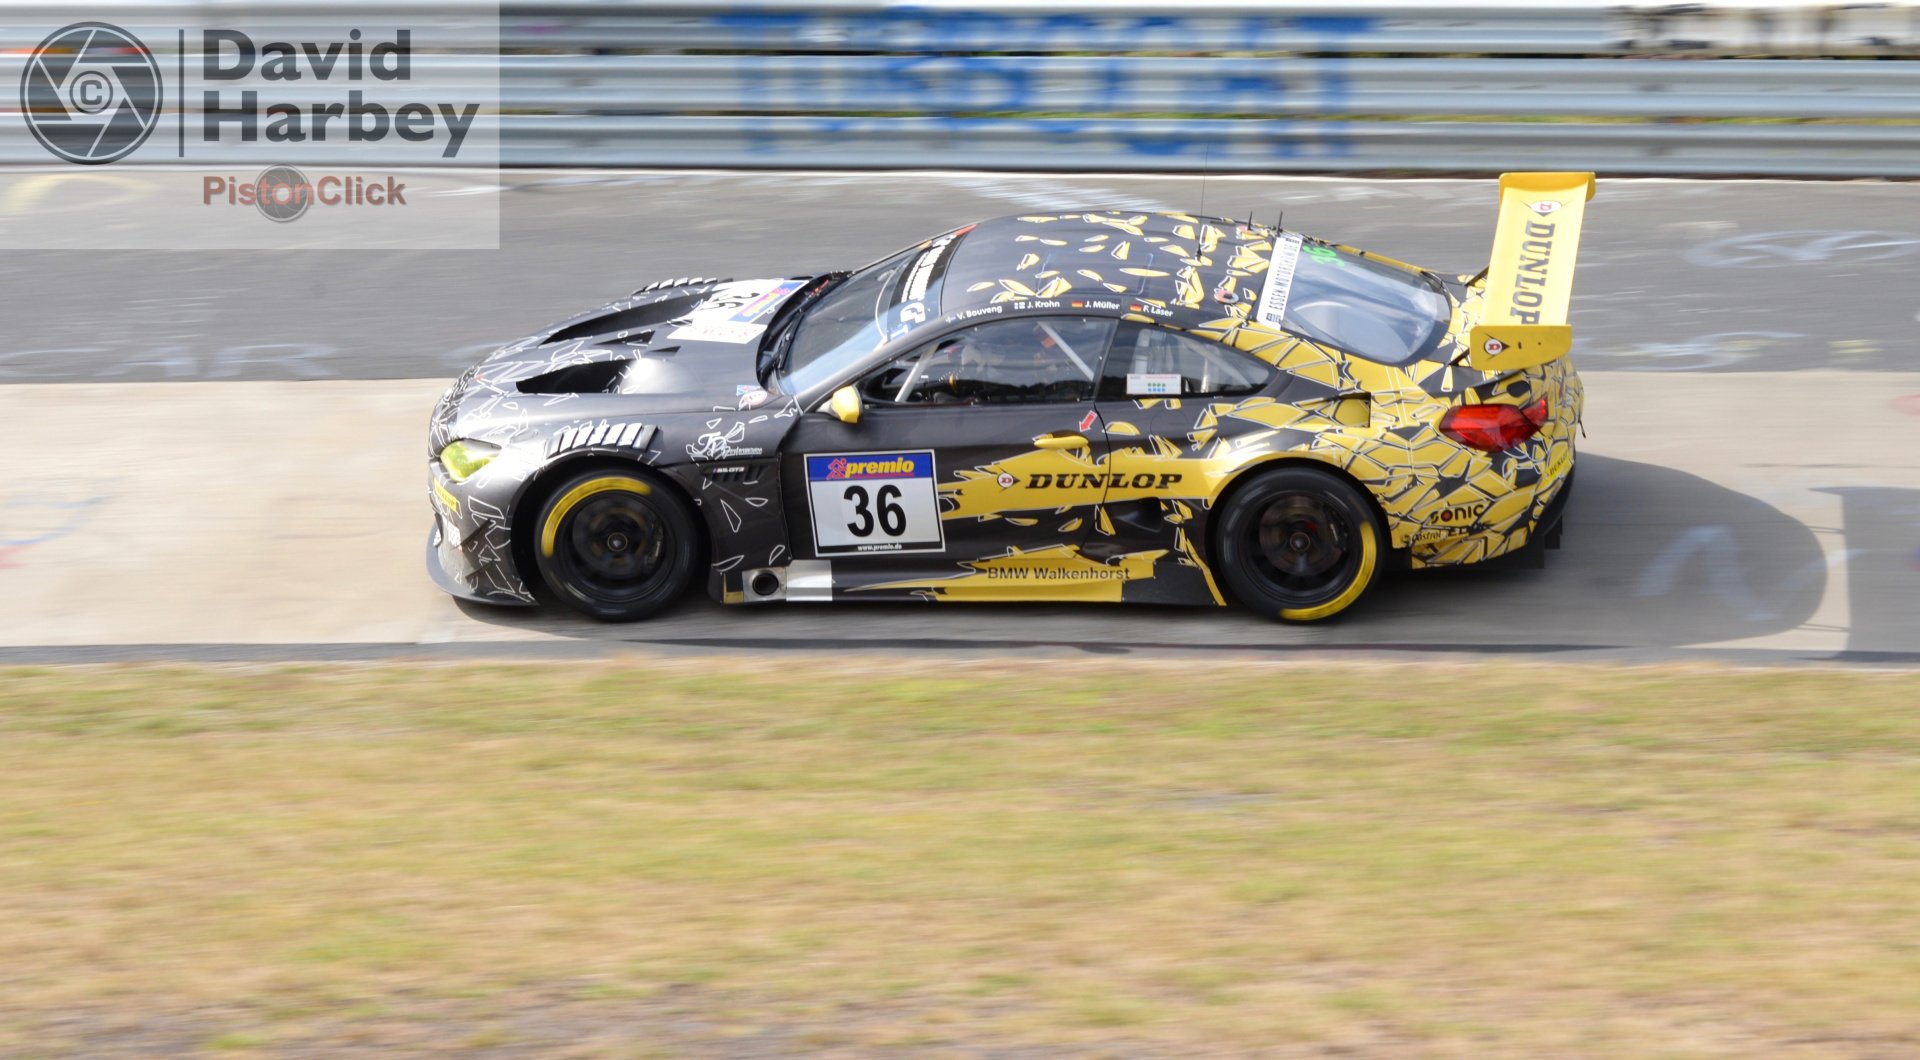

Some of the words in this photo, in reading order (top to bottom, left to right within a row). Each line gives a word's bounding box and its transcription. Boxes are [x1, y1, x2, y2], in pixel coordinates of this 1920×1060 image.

[1510, 220, 1556, 324] DUNLOP
[966, 305, 1003, 318] Bouveng
[1035, 301, 1061, 309] Krohn
[1085, 301, 1091, 309] J.
[1093, 301, 1120, 310] Müller
[1151, 306, 1174, 317] Laser
[844, 456, 915, 479] premio
[1025, 473, 1182, 489] DUNLOP
[843, 485, 907, 538] 36
[987, 567, 1029, 579] BMW
[1034, 567, 1130, 579] Walkenhorst
